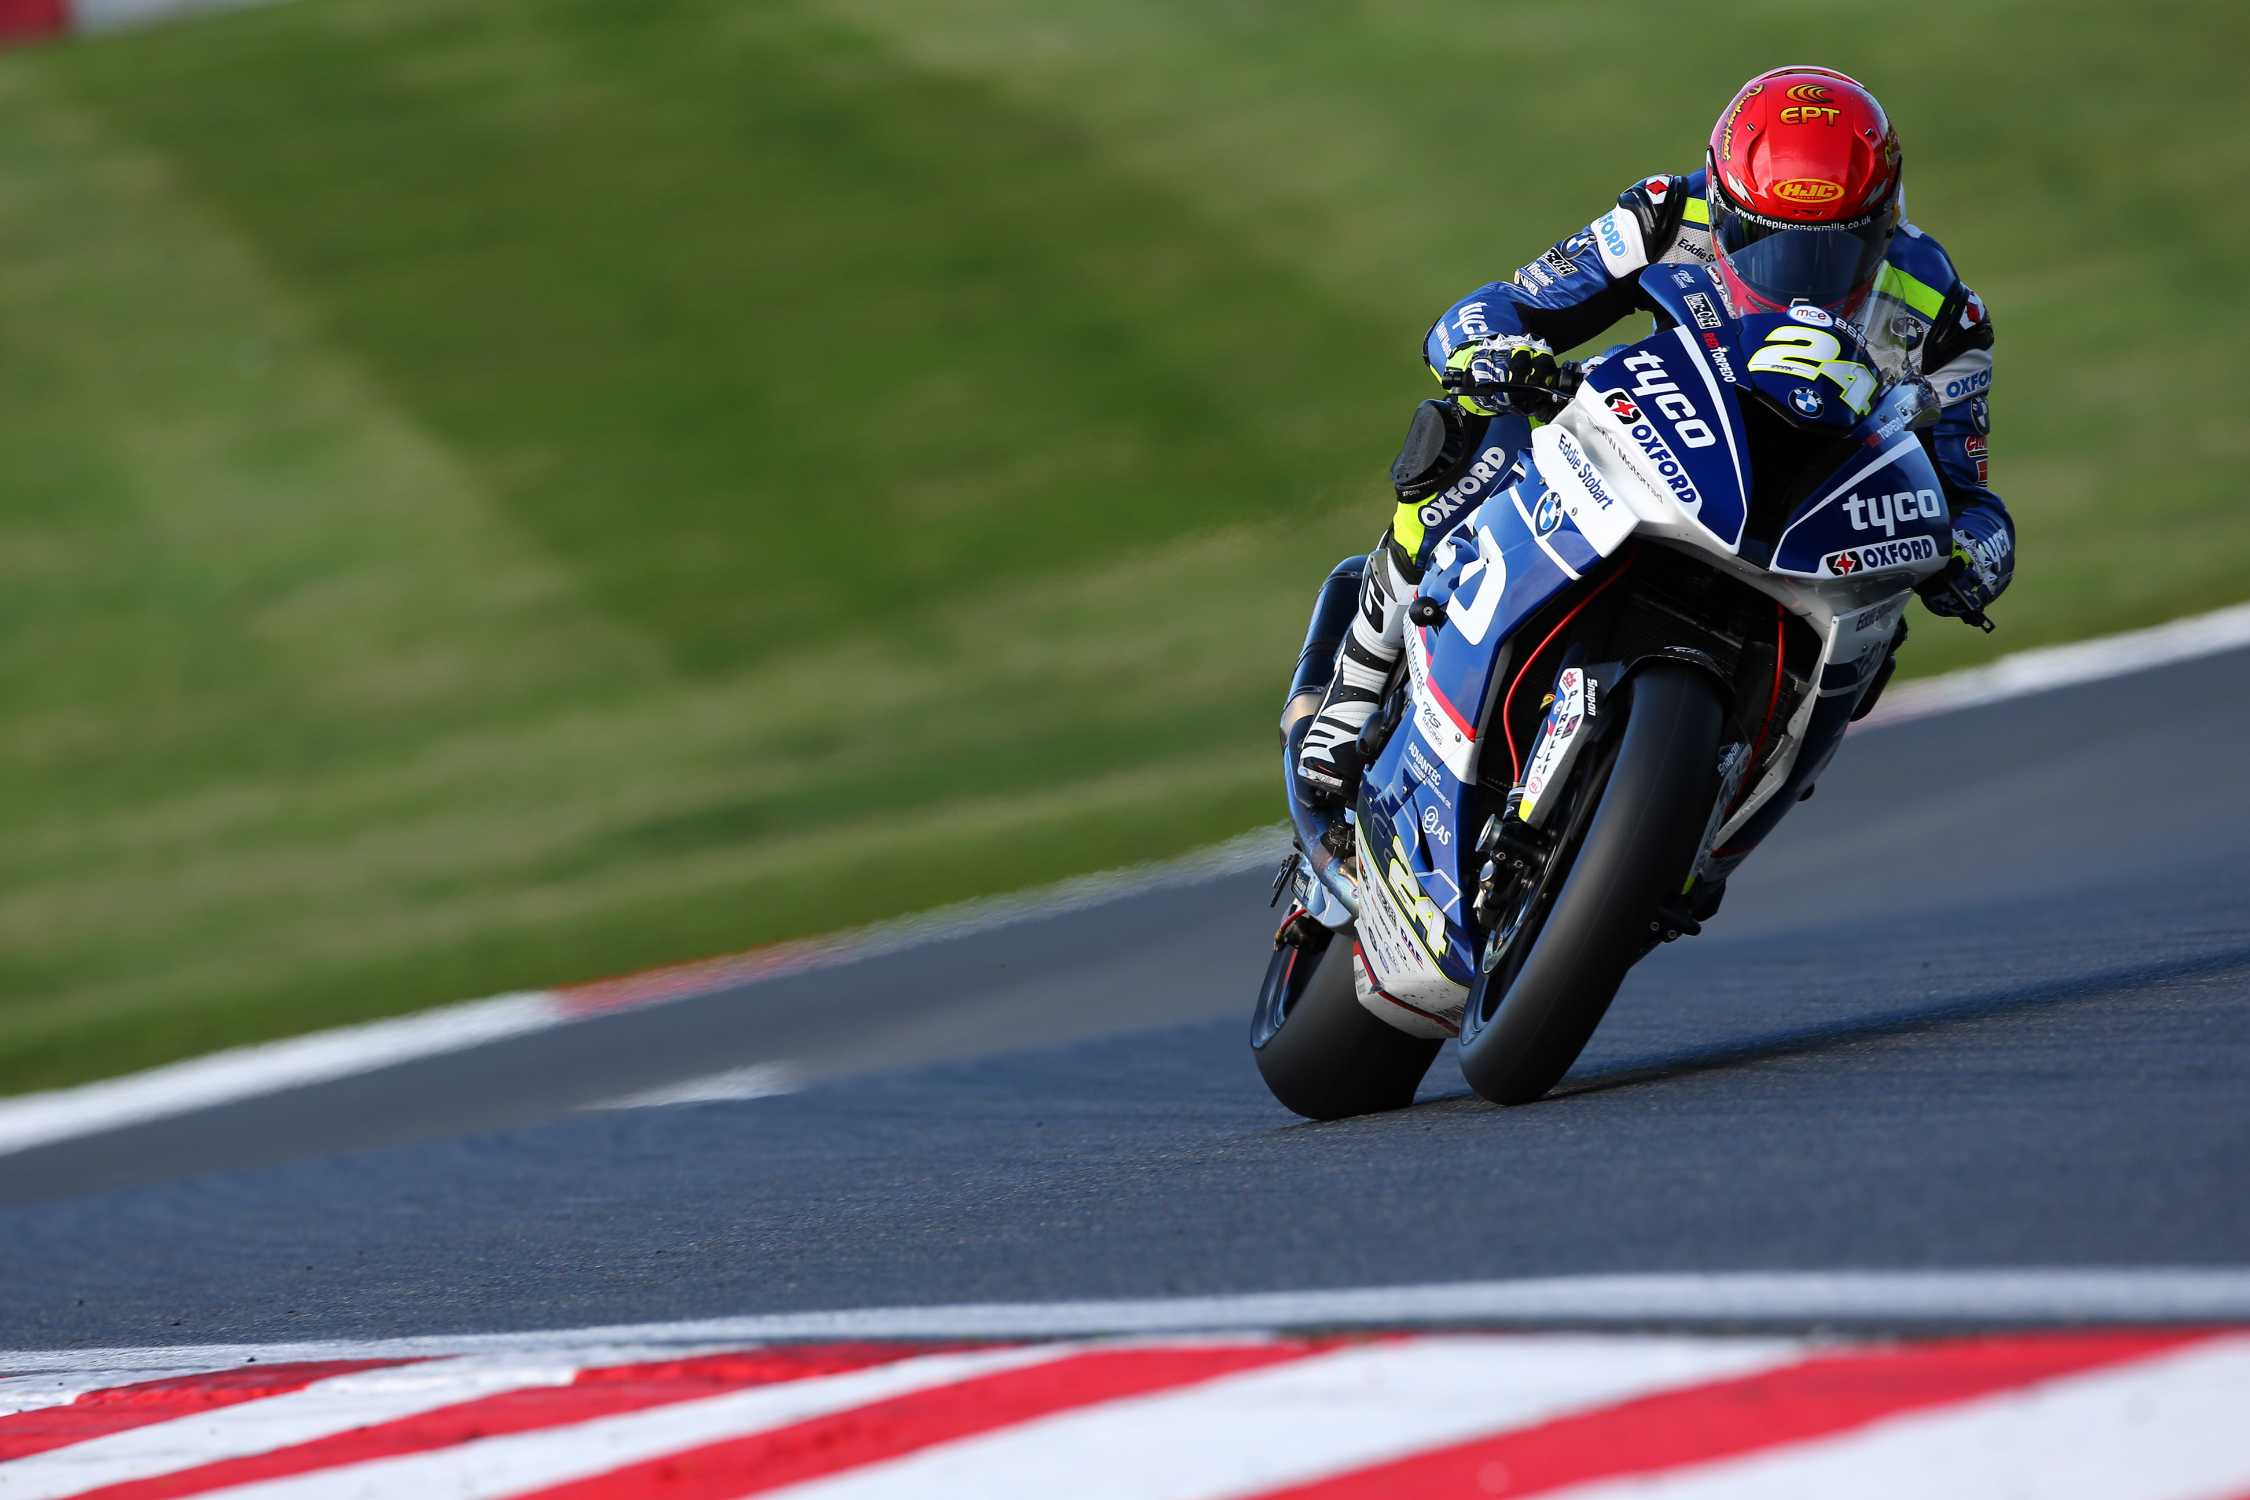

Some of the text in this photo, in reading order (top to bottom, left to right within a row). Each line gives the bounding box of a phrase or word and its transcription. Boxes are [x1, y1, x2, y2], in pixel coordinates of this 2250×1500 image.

[1780, 106, 1840, 126] EPT
[1782, 183, 1837, 197] HJC
[1598, 213, 1626, 257] FORD
[1677, 238, 1706, 261] Eddie
[1452, 302, 1488, 341] tyc
[1796, 309, 1826, 321] mce
[1747, 325, 1878, 416] 24
[1946, 366, 1992, 398] OXFO
[1623, 350, 1716, 448] tyco
[1558, 433, 1615, 510] Eddie Stobart
[1631, 424, 1696, 503] OXFORD
[1420, 446, 1506, 527] OXFORD
[1842, 489, 1941, 536] tyco
[1863, 539, 1933, 568] OXFORD
[1587, 678, 1598, 717] Snap-on
[1542, 690, 1578, 775] PIRELLI
[1408, 742, 1440, 786] ADVANTEC
[1388, 835, 1447, 958] 24
